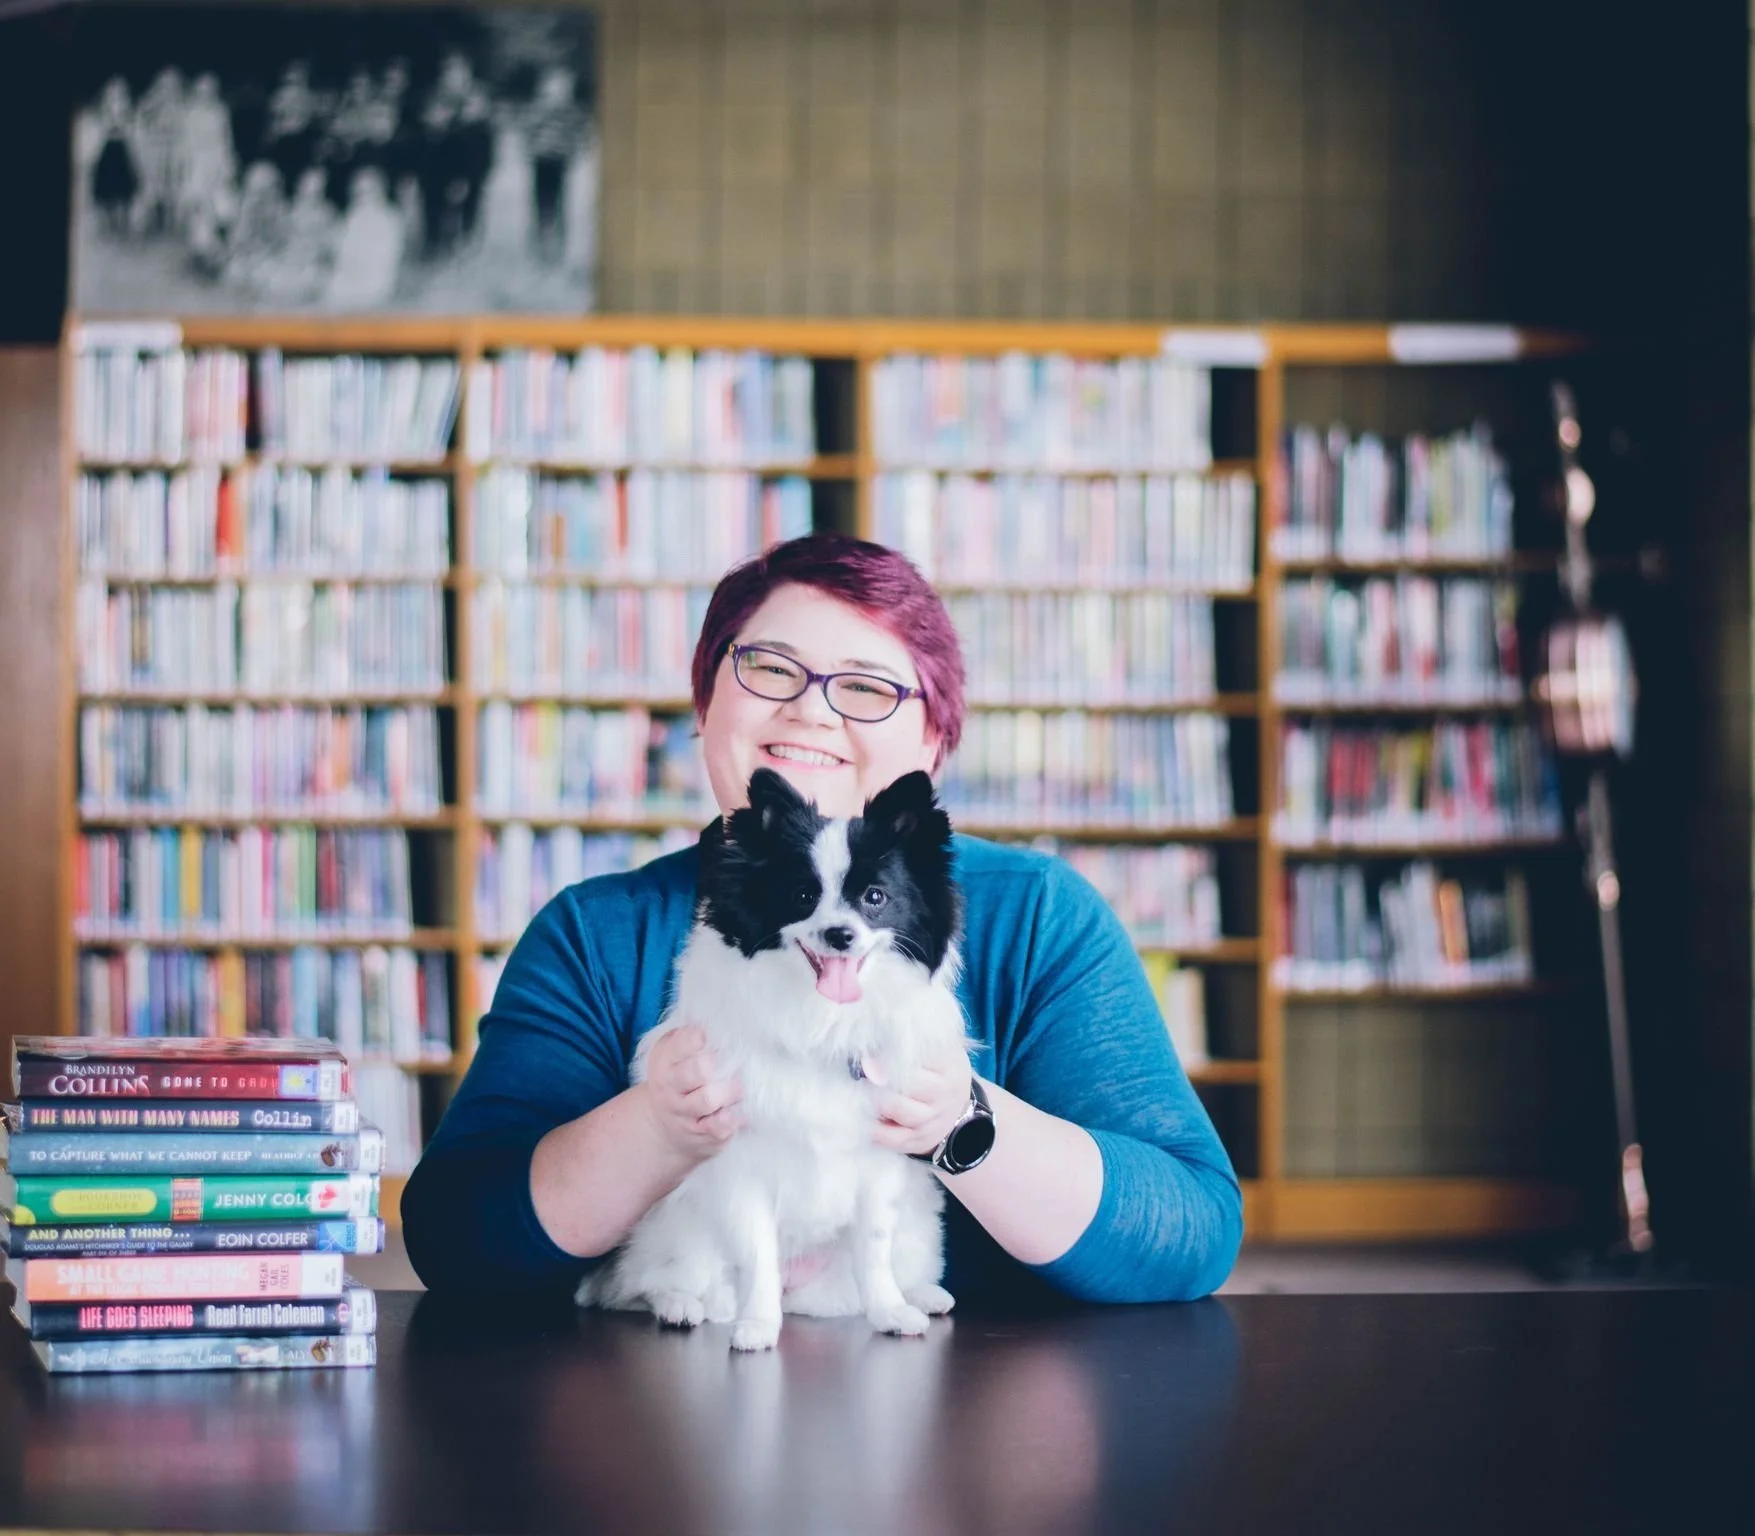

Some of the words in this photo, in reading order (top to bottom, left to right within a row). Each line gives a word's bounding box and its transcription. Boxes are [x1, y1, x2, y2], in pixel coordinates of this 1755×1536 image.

[65, 1064, 136, 1076] BRANDILYN
[48, 1075, 150, 1096] COLLINS
[162, 1076, 202, 1088] GONE
[212, 1076, 228, 1088] TO
[31, 1109, 58, 1125] THE
[63, 1109, 96, 1126] MAN
[100, 1109, 138, 1126] WITH
[143, 1110, 185, 1127] MANY
[190, 1110, 240, 1127] NAMES
[254, 1109, 312, 1127] Collin
[30, 1151, 46, 1161] TO
[51, 1151, 106, 1161] CAPTURE
[110, 1151, 144, 1161] WHAT
[148, 1151, 165, 1161] WE
[169, 1151, 217, 1161] CANNOT
[222, 1151, 252, 1161] KEEP
[215, 1193, 266, 1208] JENNY
[28, 1229, 59, 1240] AND
[63, 1228, 126, 1240] ANOTHER
[131, 1227, 190, 1239] THING...
[217, 1233, 254, 1247] EOIN
[258, 1232, 308, 1246] COLFER
[24, 1243, 55, 1251] DOUGLAS
[126, 1241, 145, 1249] GUIDE
[147, 1241, 156, 1249] TO
[157, 1240, 168, 1249] THE
[169, 1240, 194, 1249] GALAXY
[57, 1263, 113, 1284] SMALL
[117, 1262, 168, 1283] GAME
[259, 1261, 268, 1291] MEGAN
[270, 1268, 279, 1286] GAIL
[80, 1306, 103, 1329] LIFE
[105, 1305, 137, 1329] GOES
[139, 1304, 194, 1328] SLEEPING
[206, 1304, 237, 1327] Reed
[239, 1304, 272, 1326] Farrel
[274, 1303, 325, 1325] Coleman
[194, 1344, 232, 1364] Union
